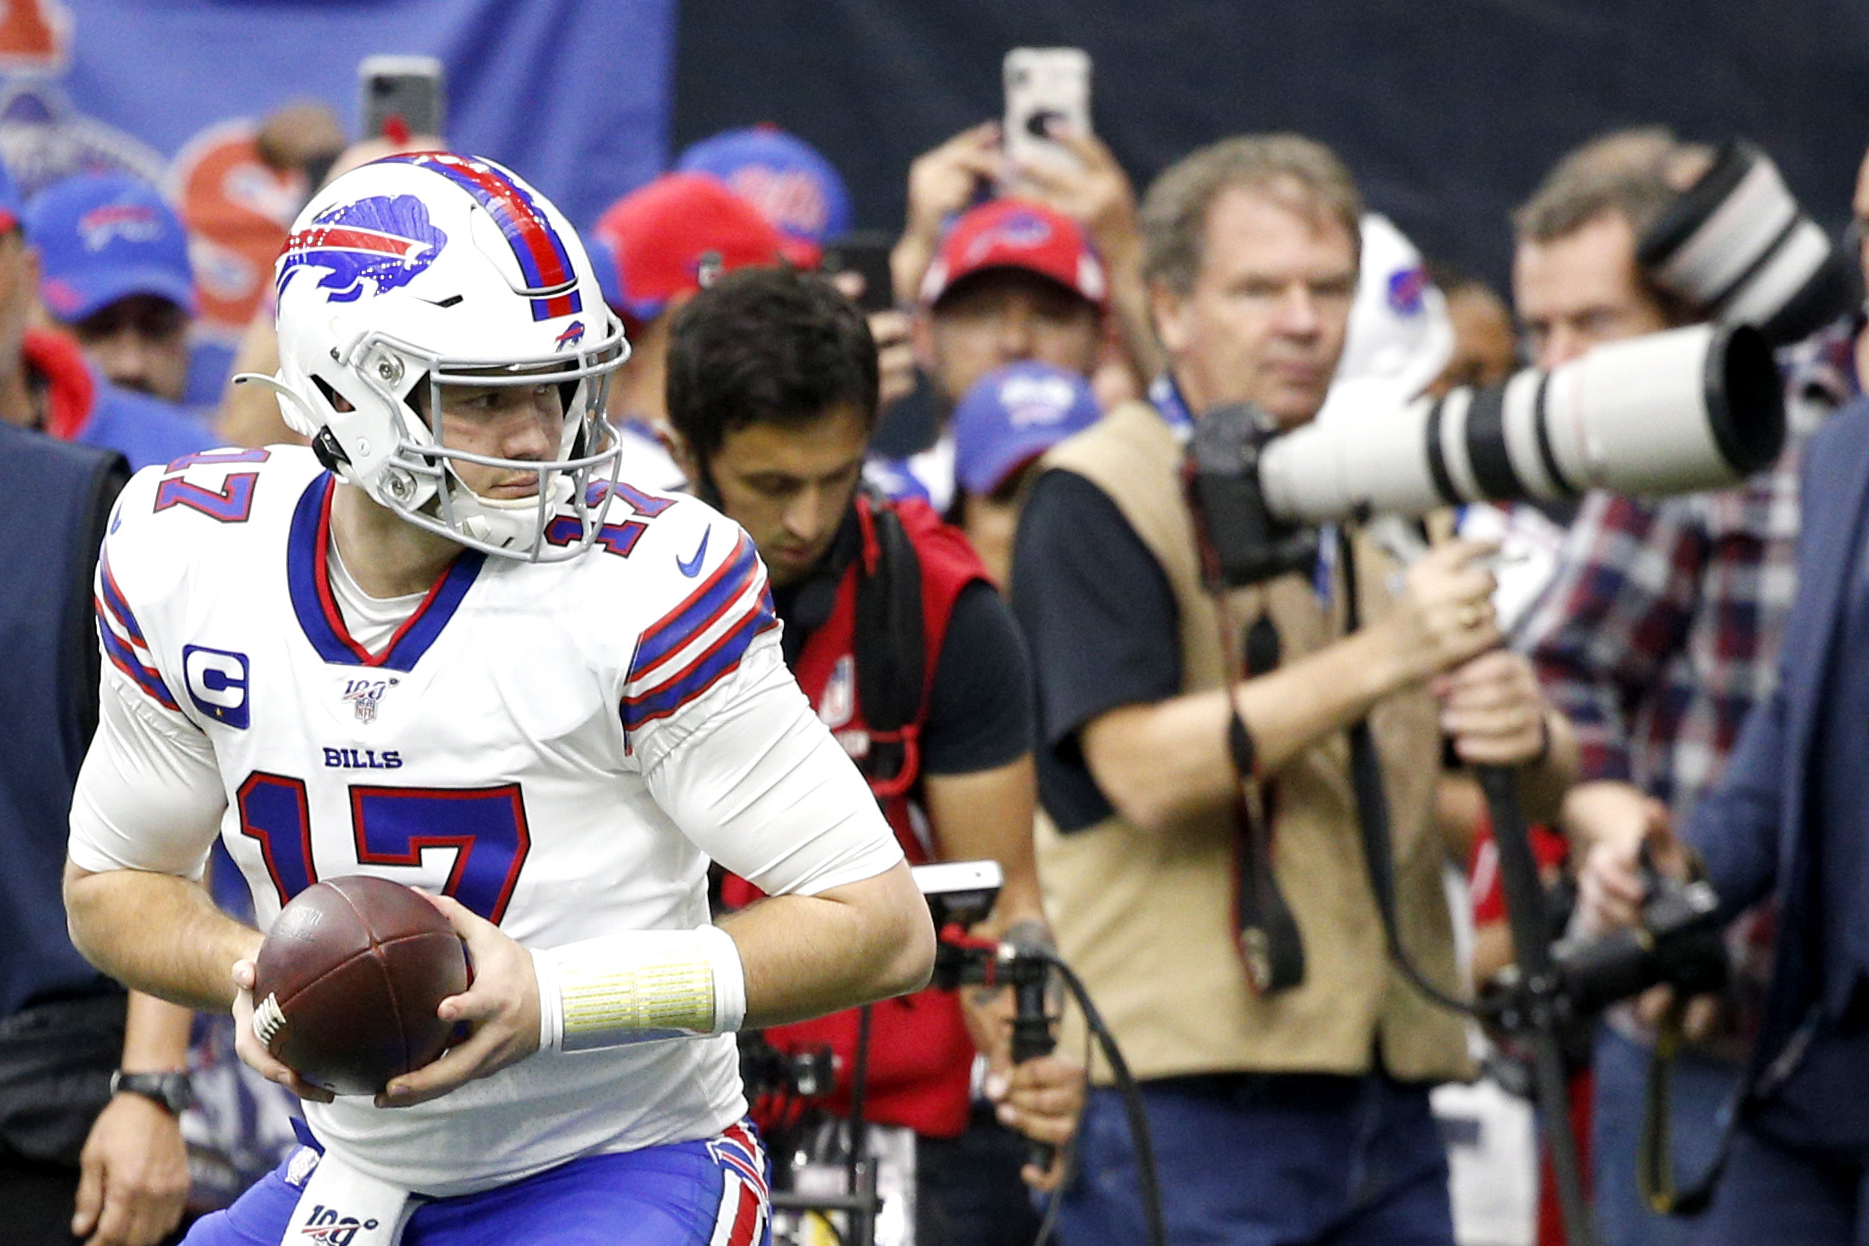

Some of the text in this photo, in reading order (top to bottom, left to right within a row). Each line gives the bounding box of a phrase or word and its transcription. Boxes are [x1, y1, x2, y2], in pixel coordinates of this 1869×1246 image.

[153, 448, 272, 523] 17
[186, 649, 246, 710] C
[322, 747, 403, 769] BILLS
[236, 769, 531, 928] 17
